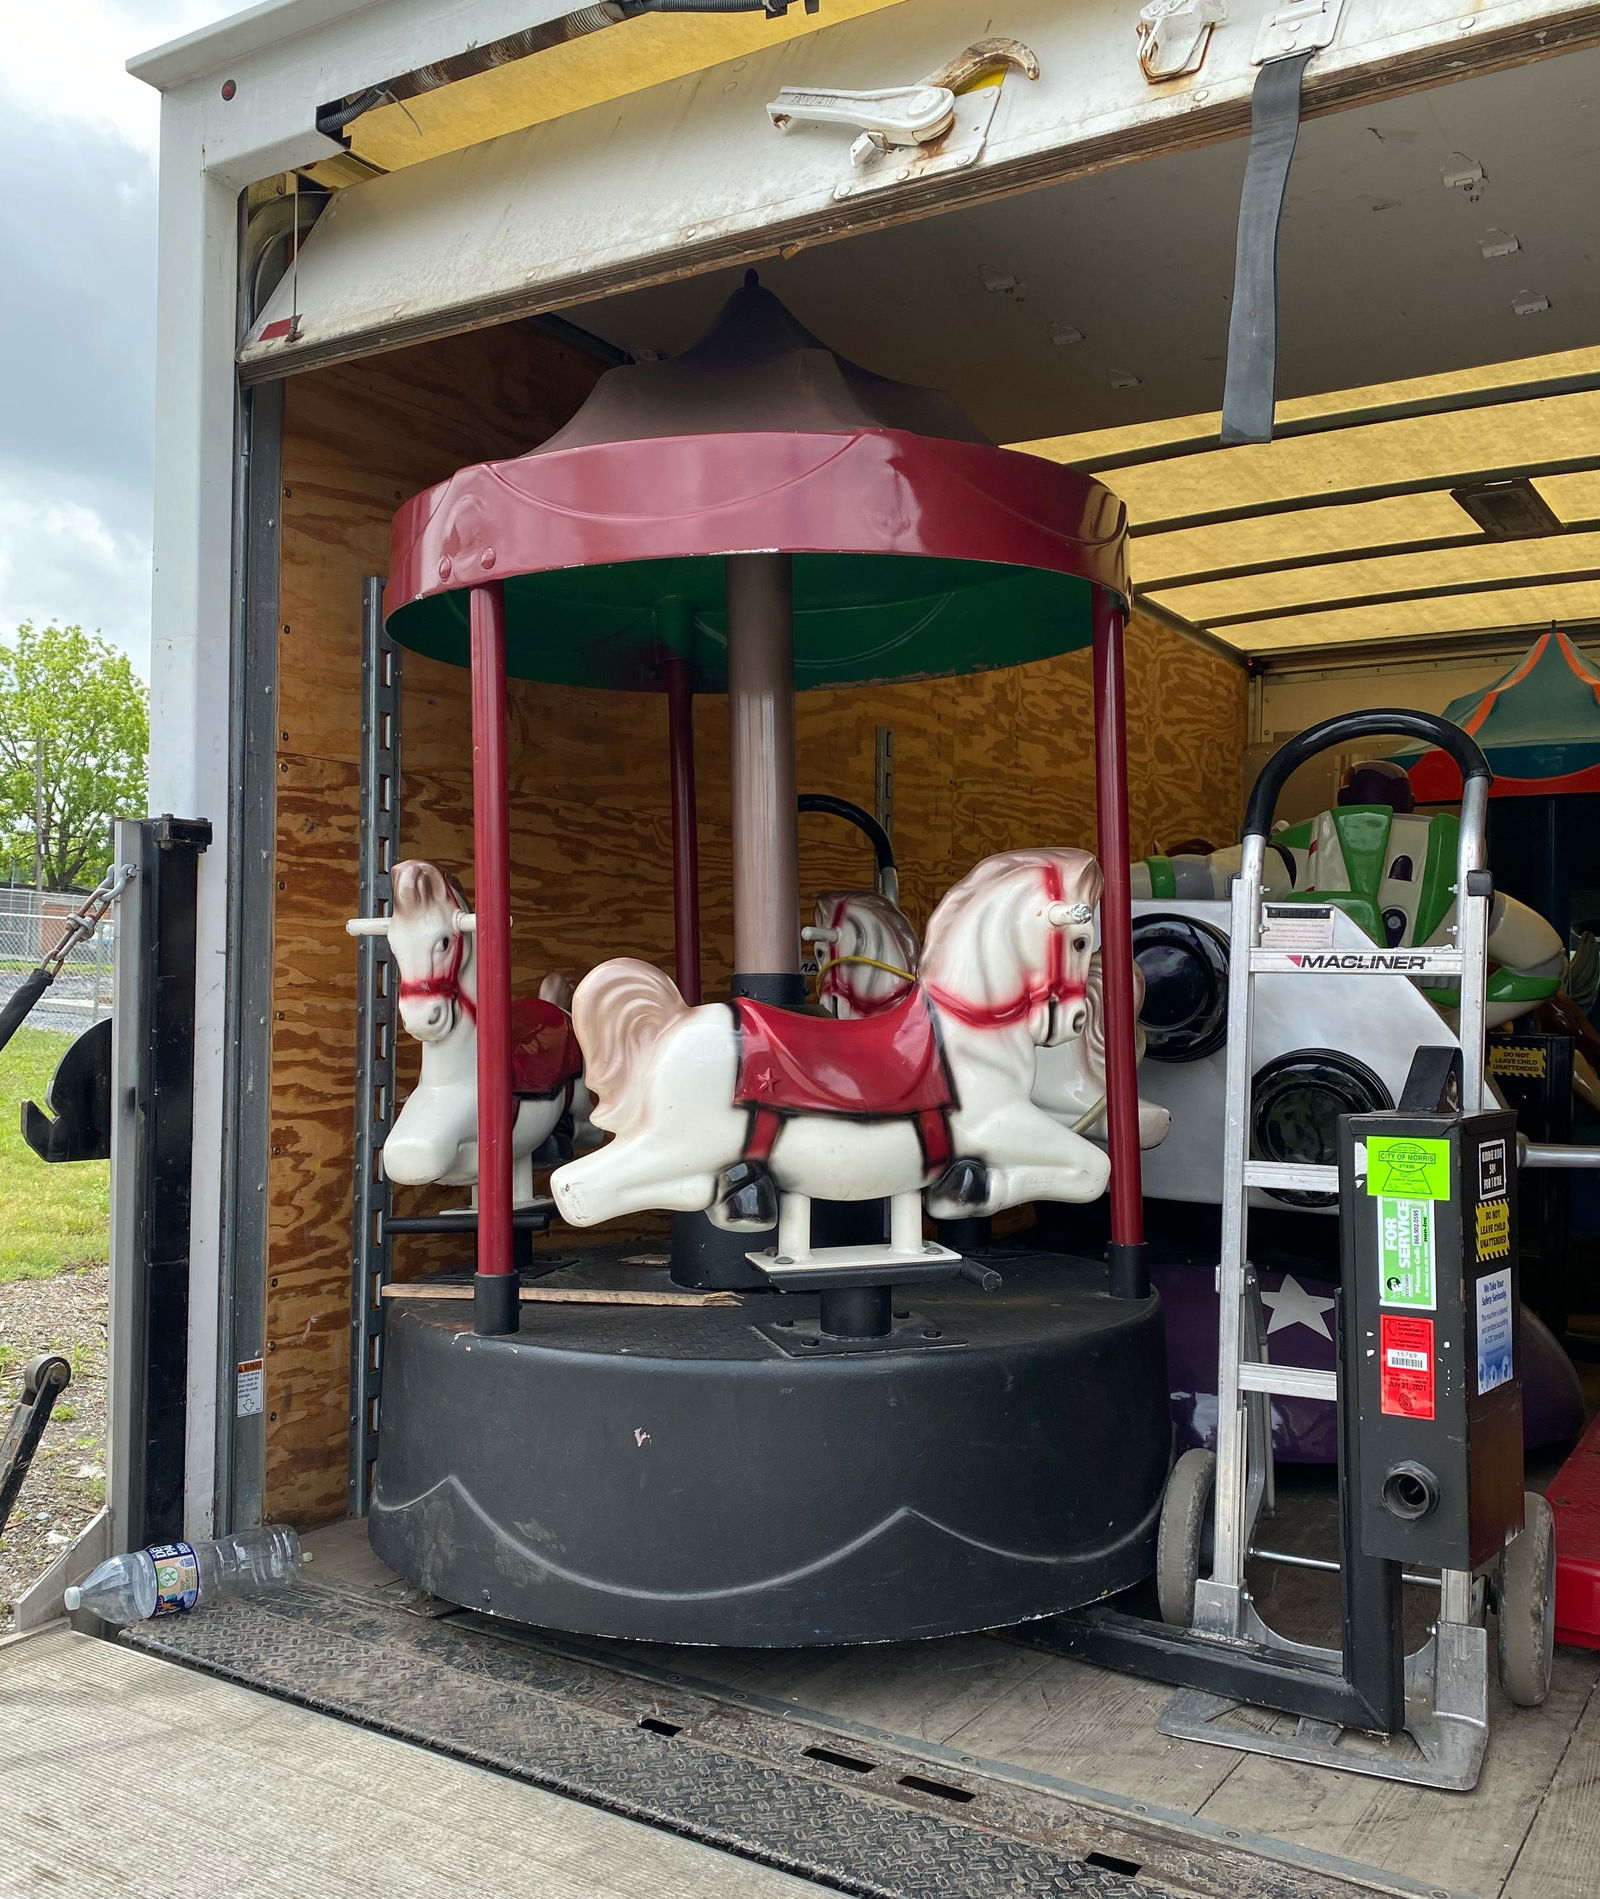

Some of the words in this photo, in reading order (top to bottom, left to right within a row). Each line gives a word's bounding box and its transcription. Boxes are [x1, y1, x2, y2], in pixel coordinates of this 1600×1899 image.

[1301, 954, 1427, 970] MAGLINER
[1493, 1064, 1540, 1072] UNATTENDED
[1380, 1152, 1395, 1160] CITY
[1407, 1154, 1434, 1162] MORRIS
[1486, 1211, 1491, 1220] DO
[1492, 1209, 1501, 1219] NOT
[1384, 1217, 1398, 1251] FOR
[1397, 1199, 1411, 1269] SERVICE
[1480, 1224, 1494, 1235] LEAVE
[1494, 1221, 1506, 1233] CHILD
[1480, 1234, 1507, 1249] UNATTENDED
[1388, 1381, 1400, 1390] July
[1401, 1382, 1411, 1390] 31,
[1412, 1383, 1427, 1391] 2021
